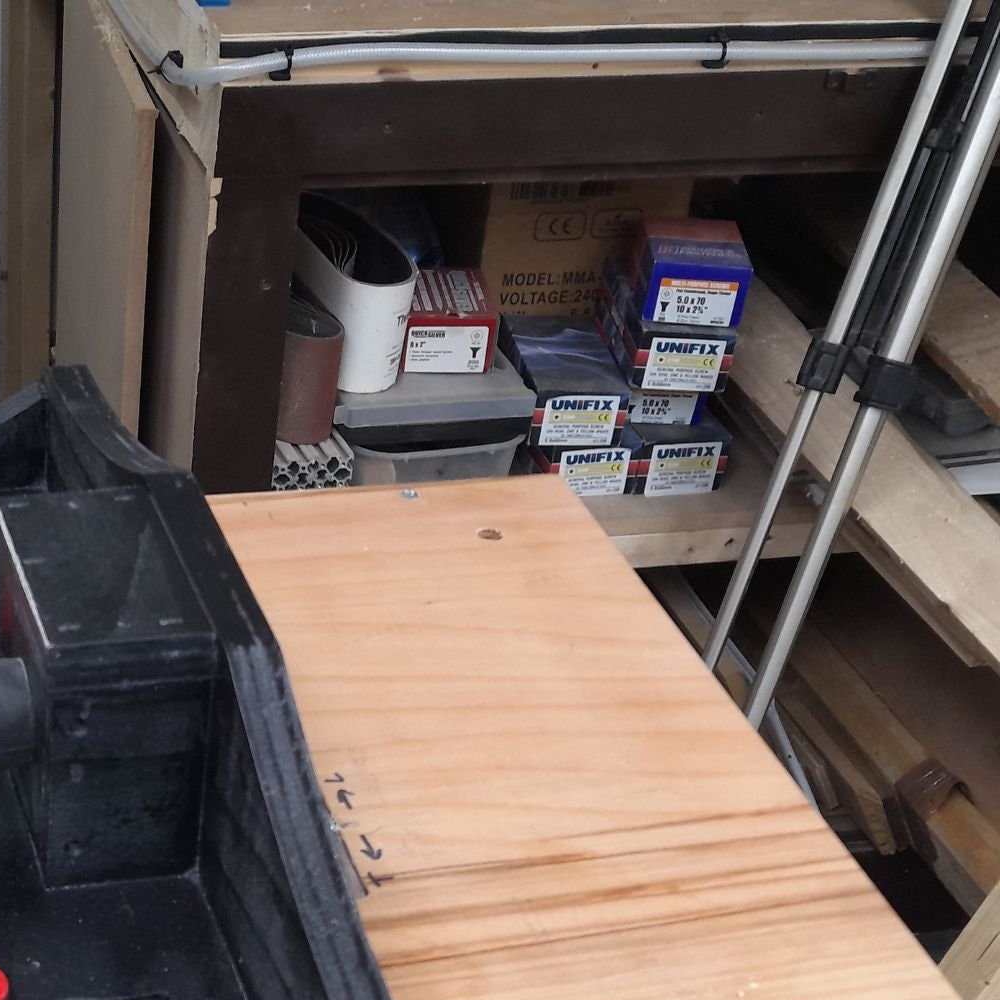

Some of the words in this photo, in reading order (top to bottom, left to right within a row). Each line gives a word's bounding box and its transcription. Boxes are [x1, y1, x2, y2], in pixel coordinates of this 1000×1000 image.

[676, 296, 689, 305] 5.0
[697, 297, 706, 306] 70
[676, 305, 685, 313] 10
[656, 342, 720, 356] UNIFIX
[551, 400, 614, 411] UNIFIX
[566, 451, 625, 465] UNIFIX
[657, 446, 716, 459] UNIFIX
